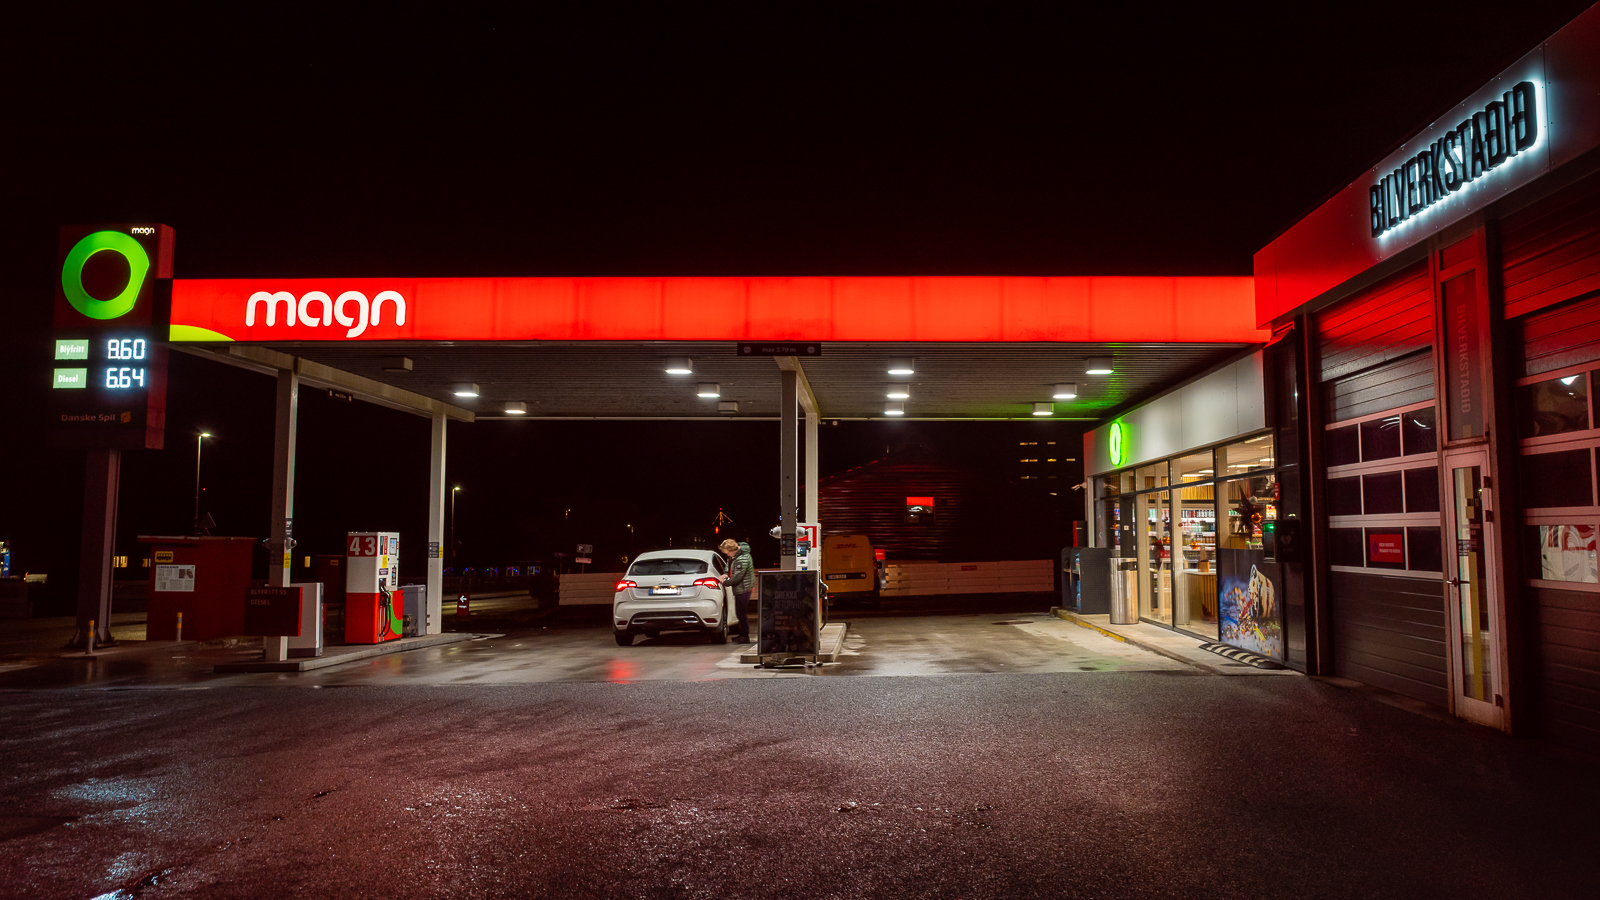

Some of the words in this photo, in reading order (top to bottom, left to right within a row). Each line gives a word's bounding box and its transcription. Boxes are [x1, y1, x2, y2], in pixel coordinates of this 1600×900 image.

[131, 226, 155, 236] magn
[245, 290, 407, 338] magn
[107, 338, 146, 360] 8.60
[57, 374, 79, 383] Diesel
[105, 367, 144, 388] 6.64
[60, 413, 97, 422] Danske
[98, 413, 116, 423] Spil
[774, 590, 798, 600] DREKKA
[250, 598, 270, 606] DIESEL
